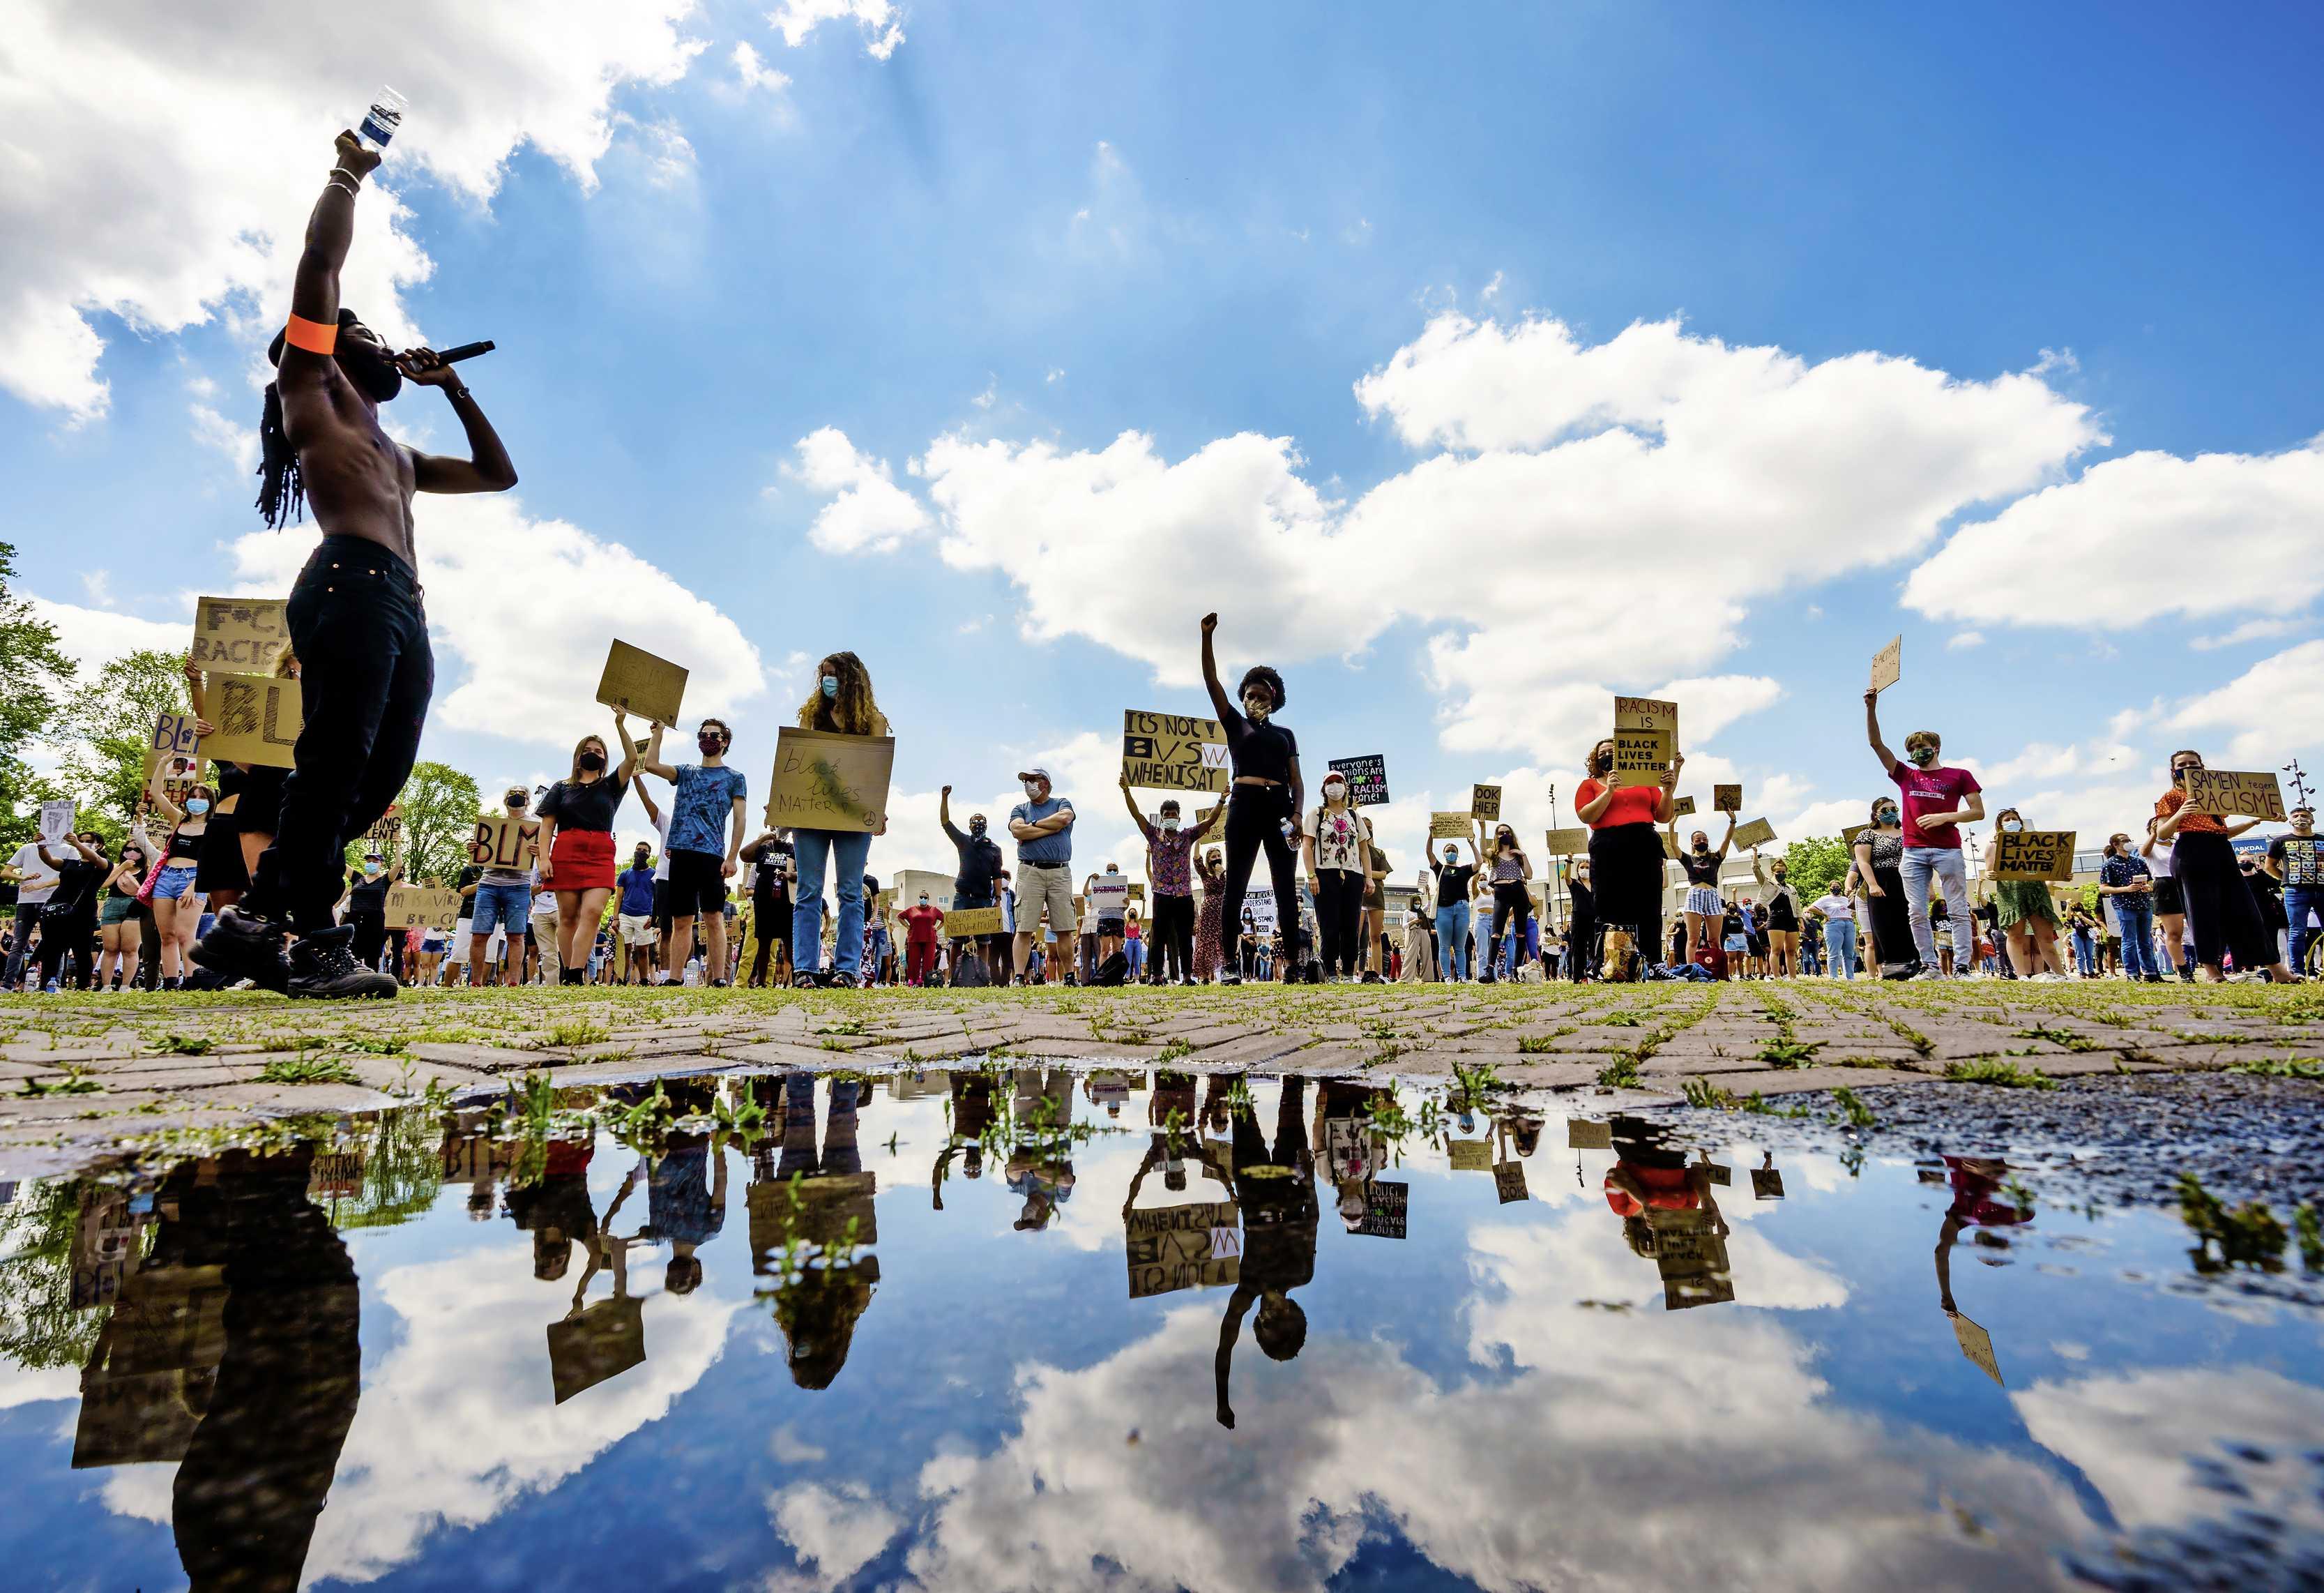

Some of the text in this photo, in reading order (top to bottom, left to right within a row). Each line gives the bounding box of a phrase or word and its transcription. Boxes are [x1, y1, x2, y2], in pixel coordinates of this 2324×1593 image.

[218, 680, 305, 748] BL
[1618, 698, 1676, 720] RACISM
[1641, 716, 1653, 728] IS
[1618, 740, 1659, 749] BLACK
[1202, 746, 1228, 766] W
[1618, 751, 1653, 760] LIVES
[1331, 758, 1381, 770] everyone's
[1618, 762, 1667, 771] MATTER
[1185, 766, 1217, 790] SAY
[2191, 770, 2275, 792] SAMEN tegen
[1353, 784, 1387, 795] RACISM
[1475, 788, 1500, 801] OOK
[43, 801, 75, 810] BLACK
[1473, 800, 1498, 815] HIER
[2194, 789, 2279, 815] RACISME
[473, 822, 540, 869] BLM
[2003, 833, 2069, 848] BLACK
